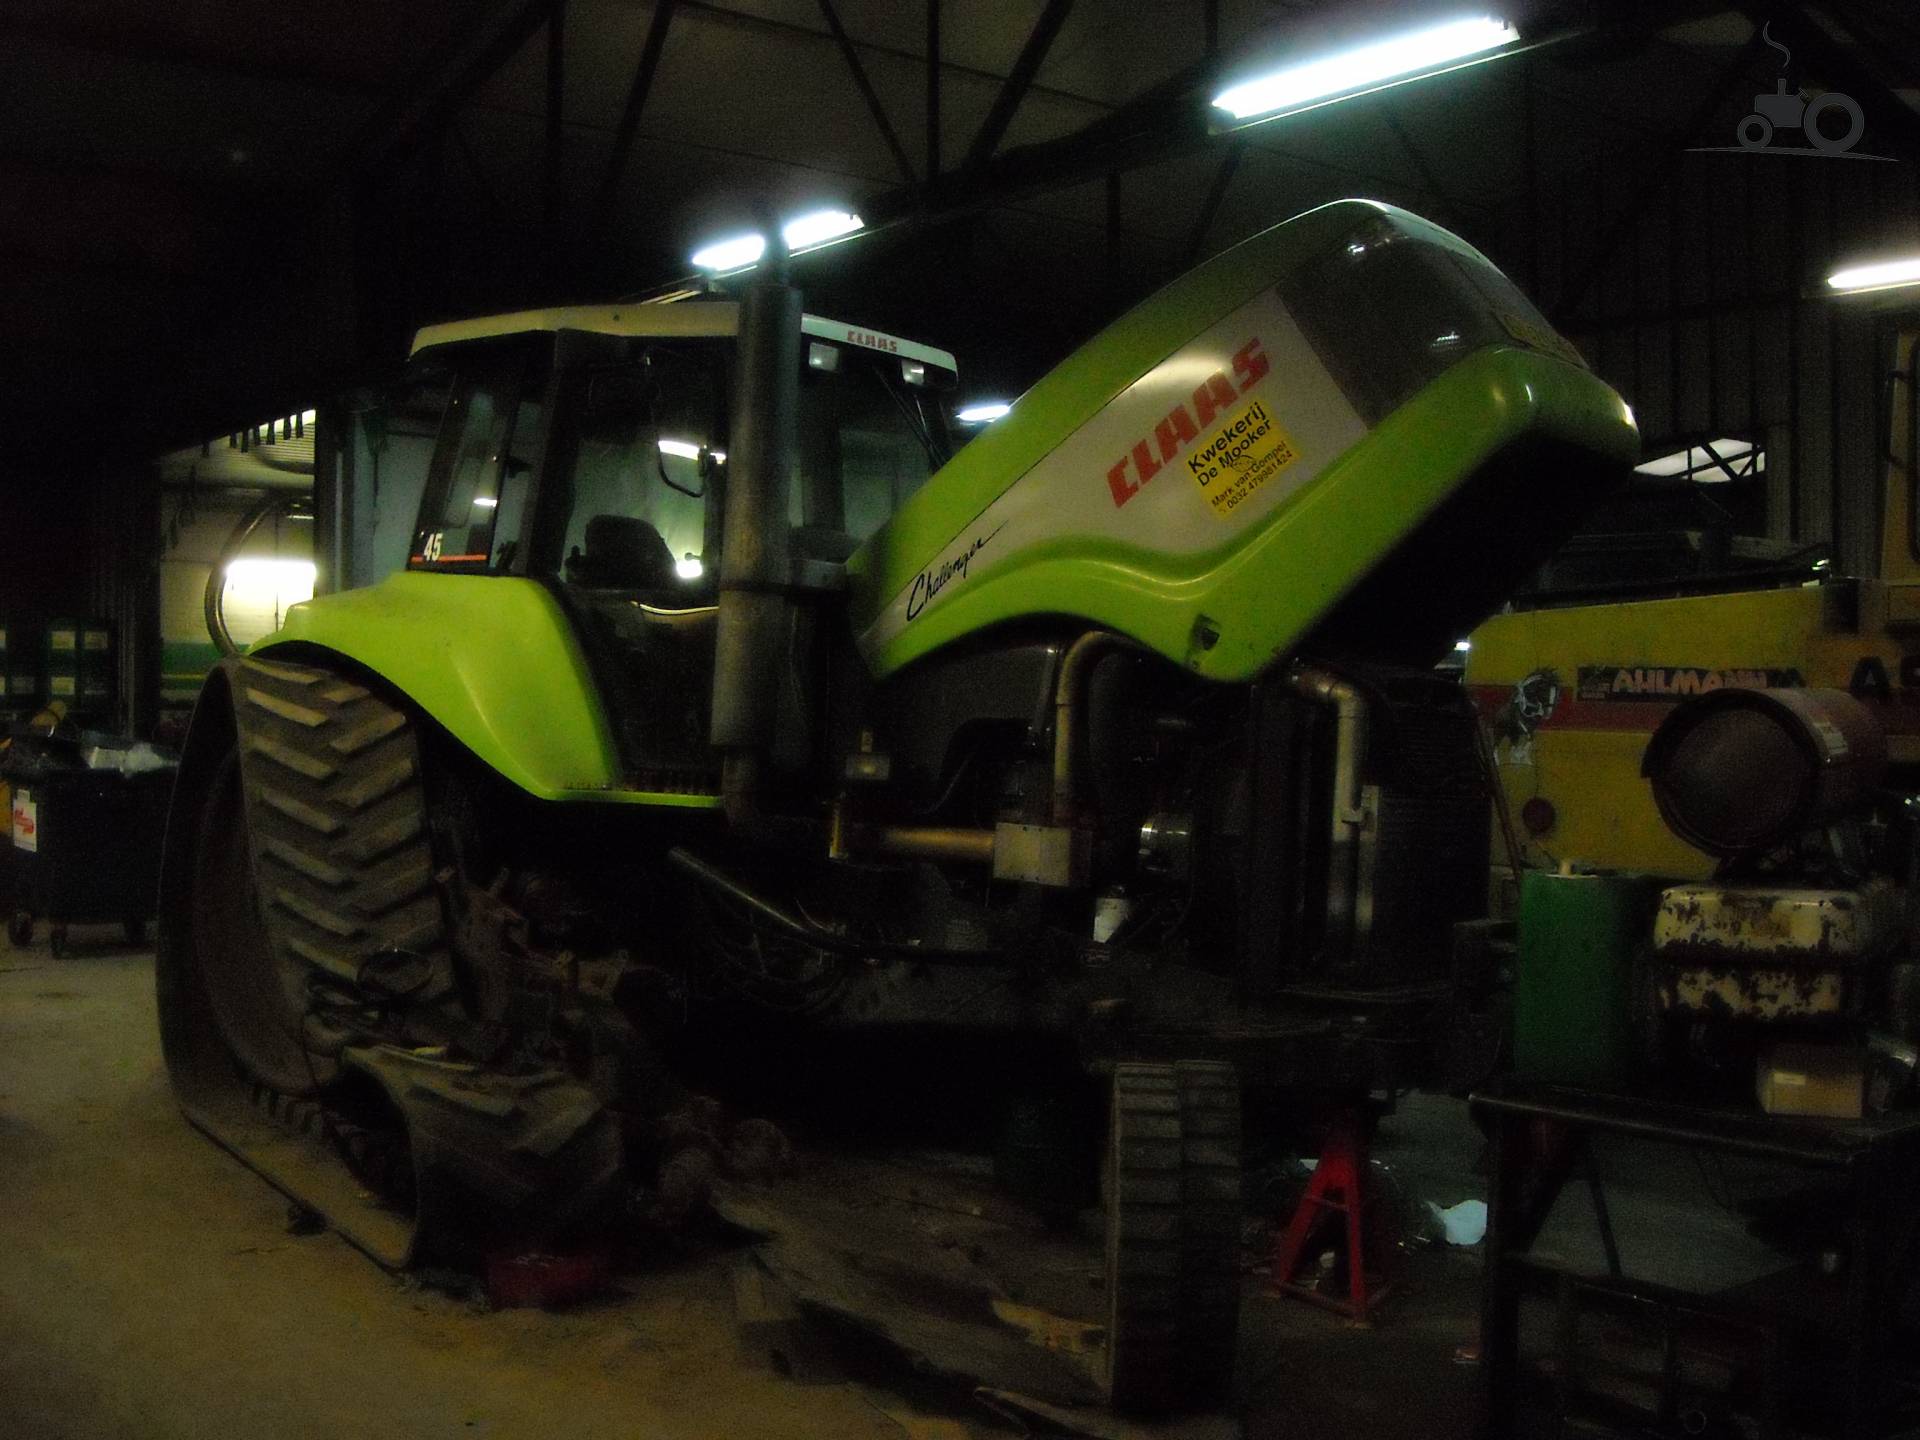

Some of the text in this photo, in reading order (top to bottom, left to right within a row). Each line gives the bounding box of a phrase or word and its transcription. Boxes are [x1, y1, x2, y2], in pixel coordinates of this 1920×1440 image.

[847, 330, 897, 353] CLAAS
[1106, 337, 1270, 509] CLAAS
[1187, 401, 1267, 475] Kwekerij
[1197, 419, 1271, 488] De Mooker
[1211, 487, 1235, 507] Mark
[1234, 471, 1251, 488] van
[1226, 487, 1249, 509] 0032
[423, 532, 444, 562] 45
[906, 519, 1009, 622] Challenger
